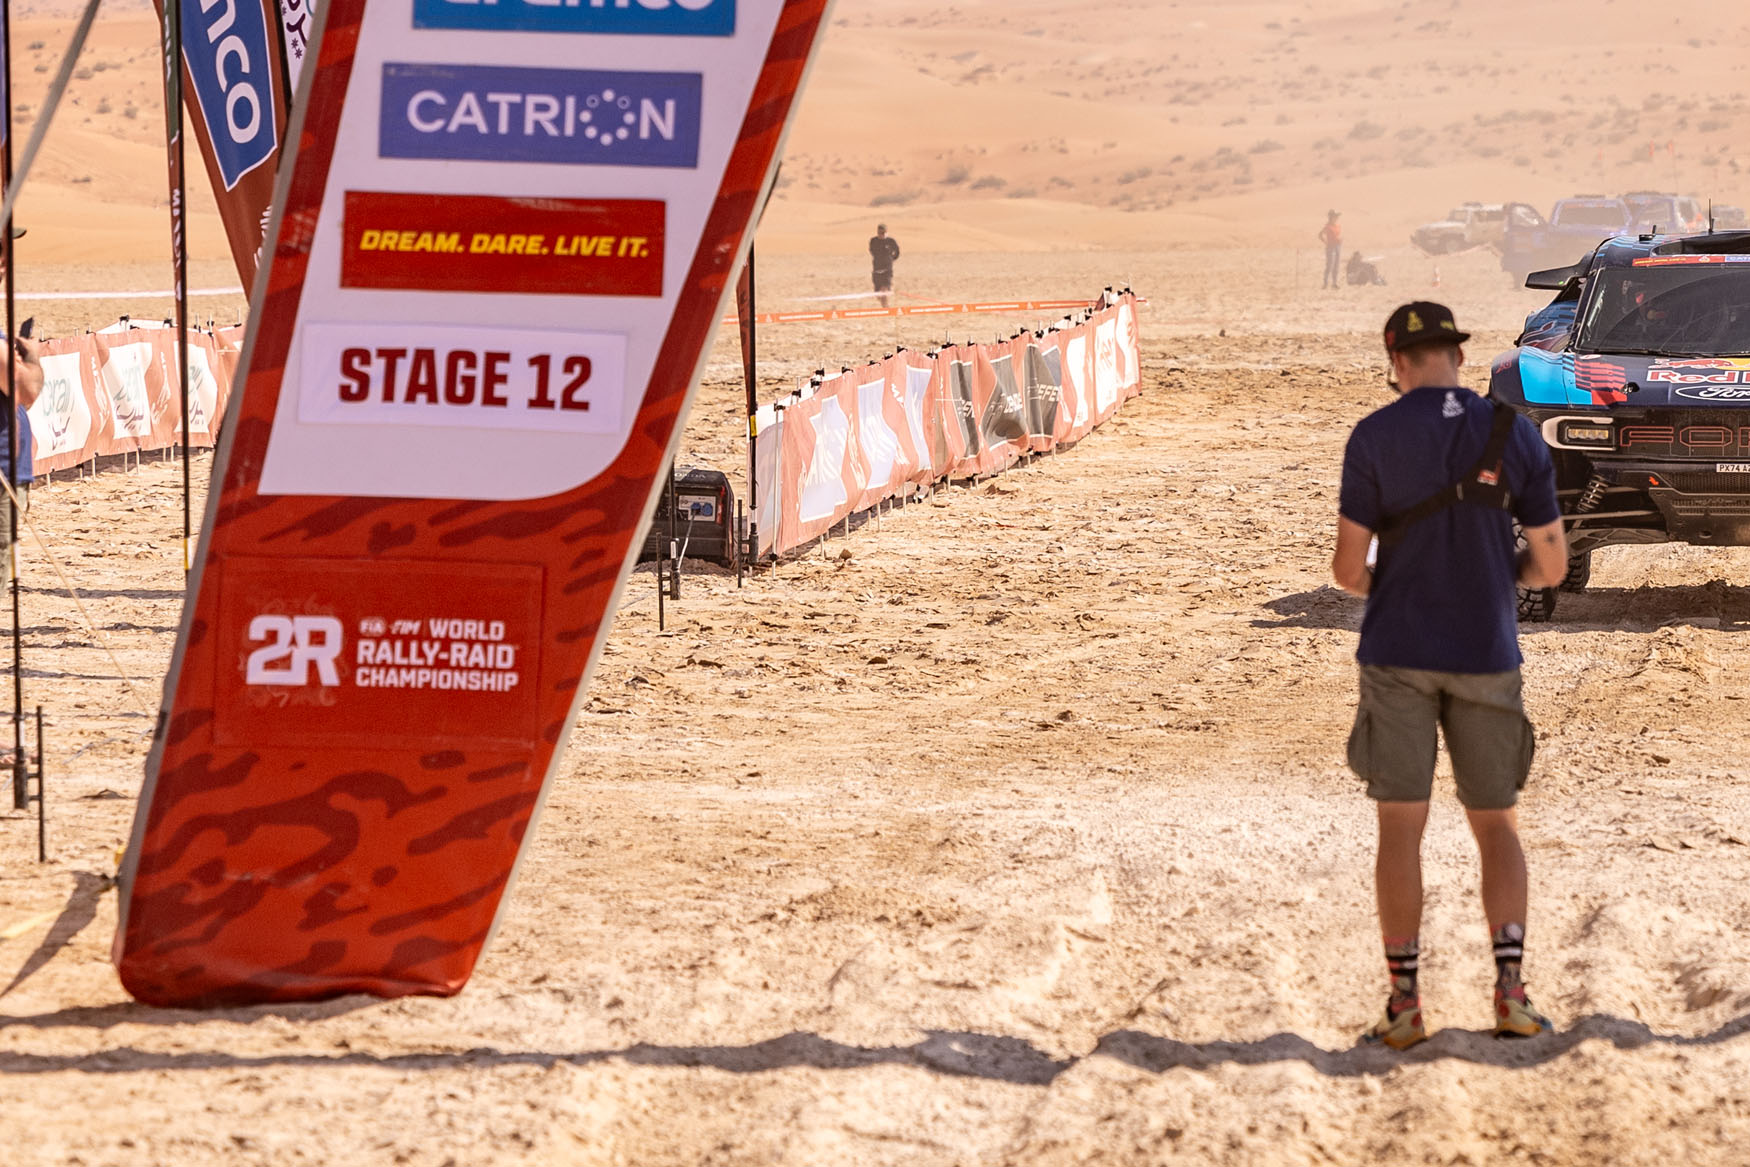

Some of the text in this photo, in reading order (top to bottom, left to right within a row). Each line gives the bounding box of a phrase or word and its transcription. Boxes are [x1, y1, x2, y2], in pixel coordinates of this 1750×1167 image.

[407, 89, 677, 146] CATRION
[359, 229, 649, 258] DREAM. DARE. LIVE IT.
[338, 347, 593, 412] STAGE 12
[1646, 370, 1739, 383] Red
[428, 618, 505, 641] WORLD
[356, 639, 516, 669] RALLY-RAID
[355, 667, 519, 692] CHAMPIONSHIP
